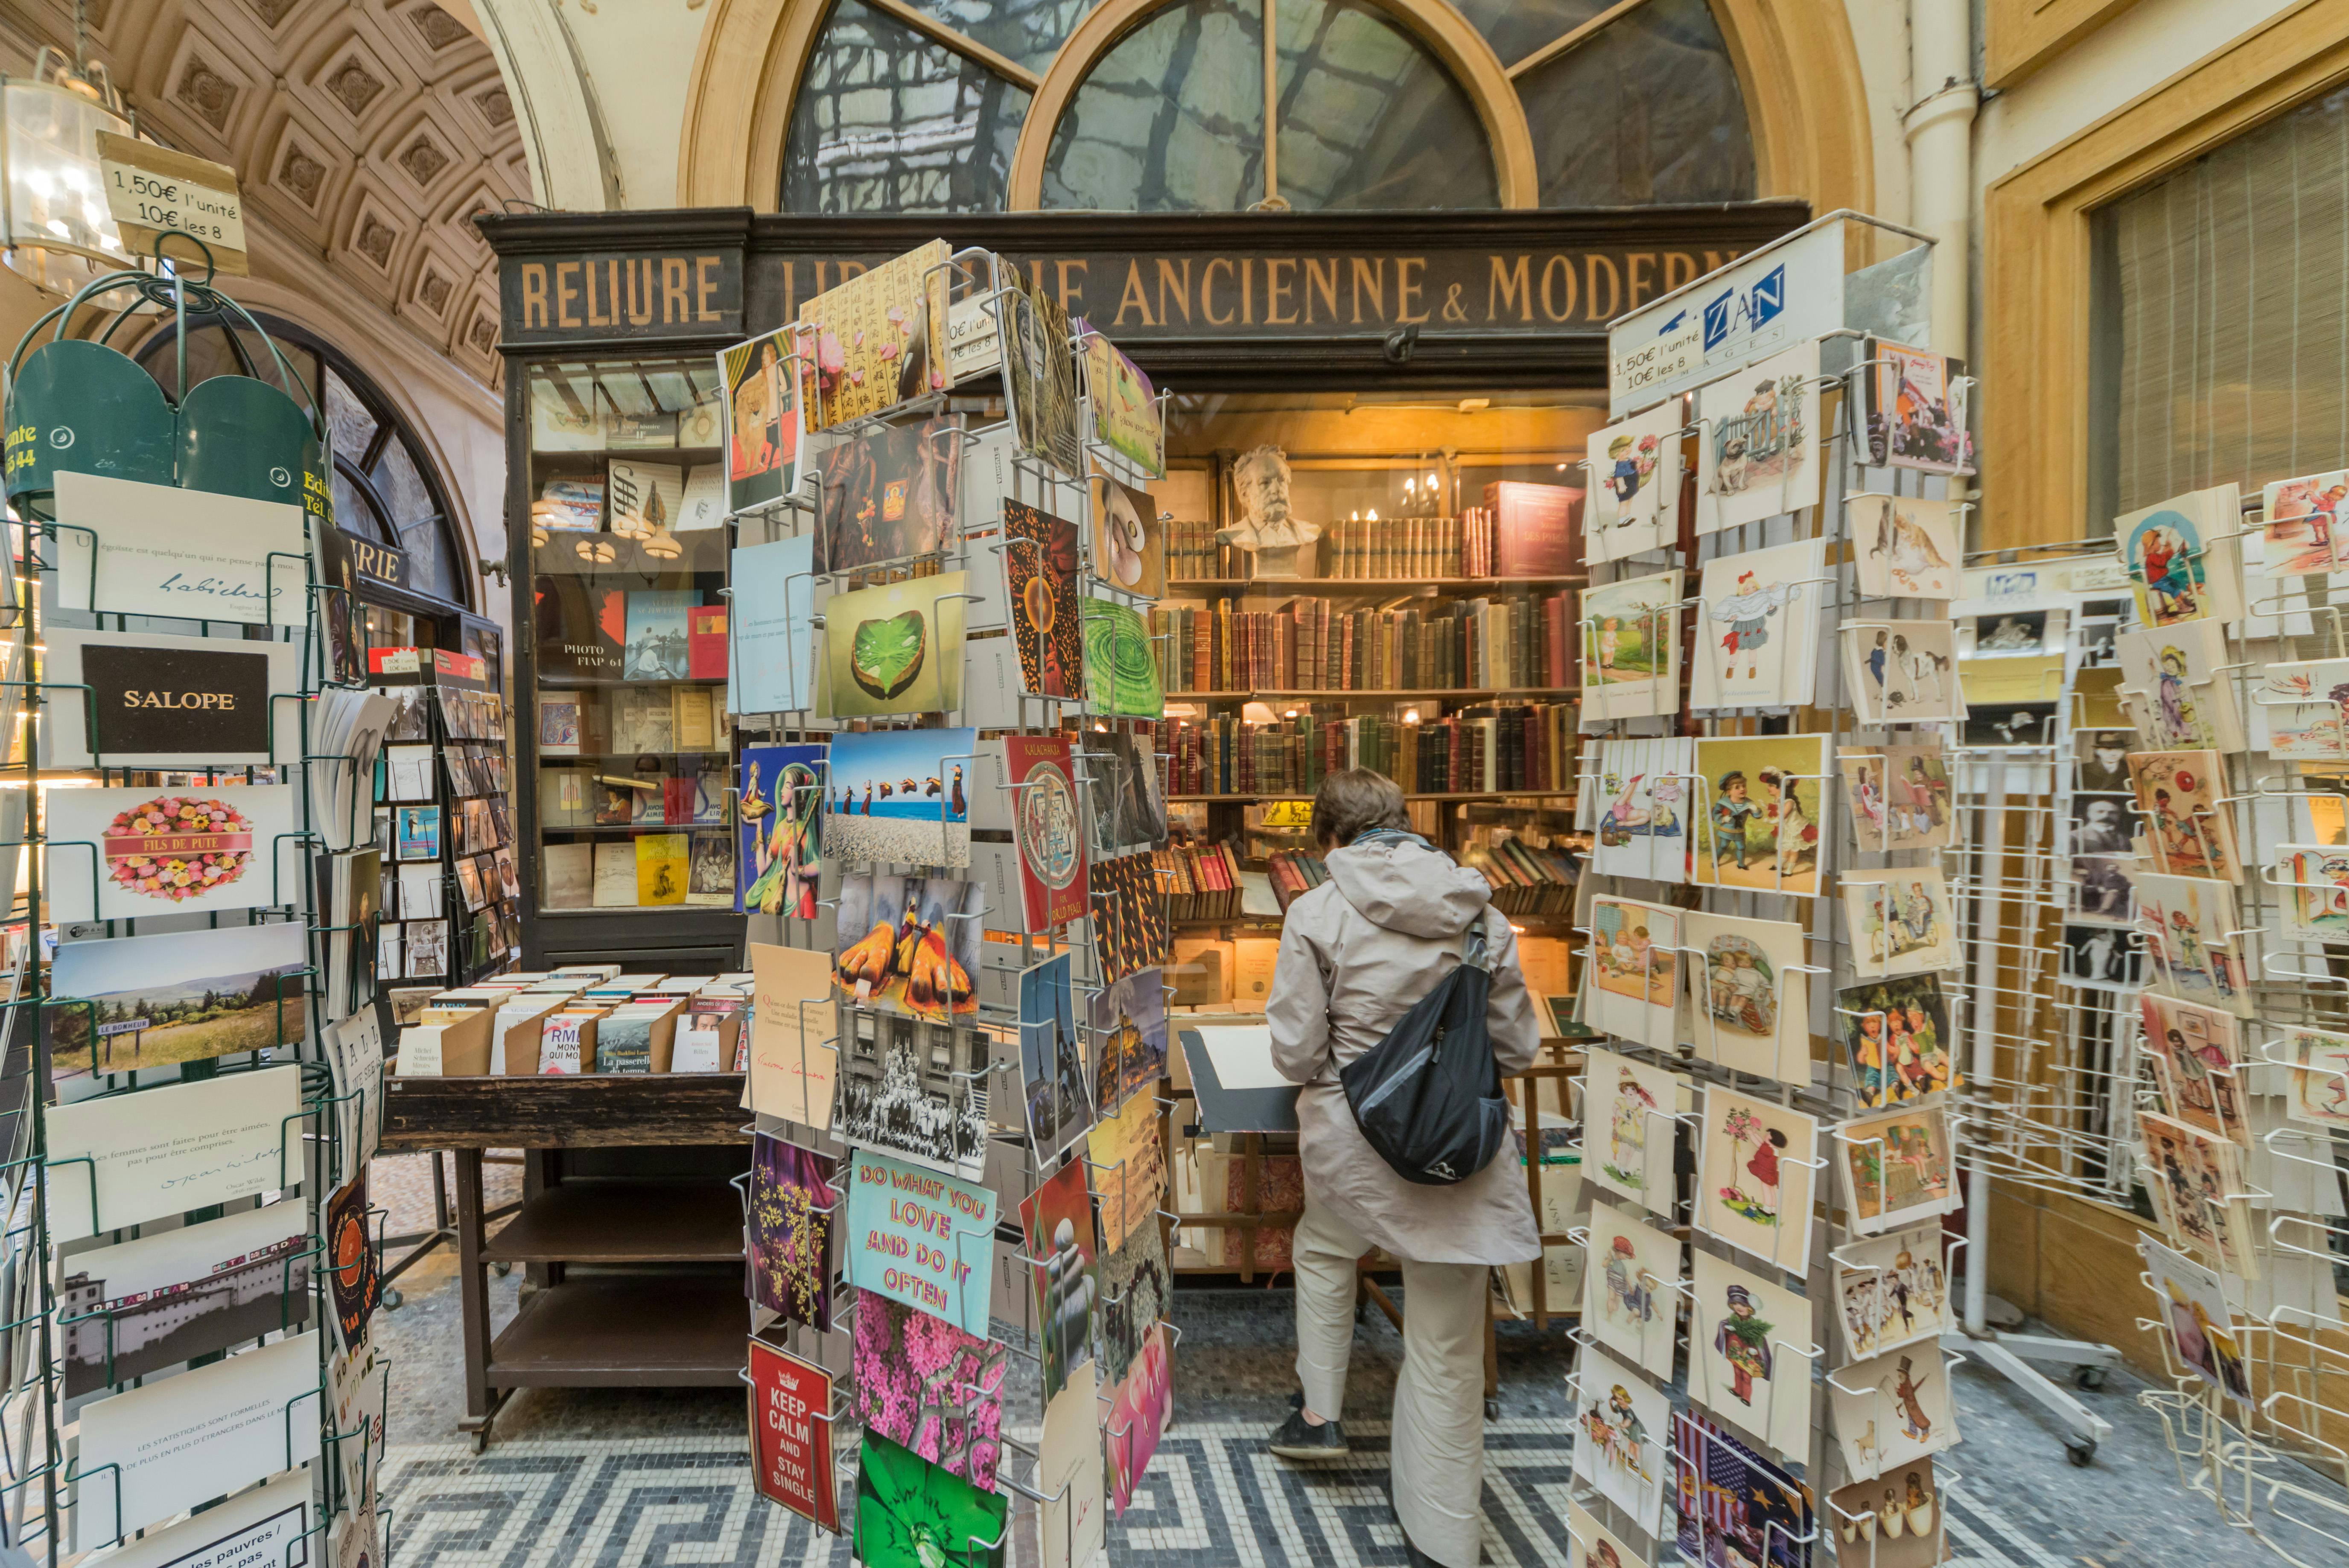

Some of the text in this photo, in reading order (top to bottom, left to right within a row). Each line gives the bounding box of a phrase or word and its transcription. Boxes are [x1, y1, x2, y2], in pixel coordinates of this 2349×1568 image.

[115, 170, 237, 220] 1,50€ l'unité
[139, 202, 222, 240] 10€ les 8
[521, 256, 721, 329] RELIURE
[1114, 256, 1429, 327] ANCIENNE
[1443, 282, 1468, 321] &
[968, 335, 991, 354] les 8
[1615, 330, 1700, 378] 1,50€ l'unité
[1627, 357, 1686, 390] 10€ les 8
[16, 449, 36, 468] 44
[303, 493, 325, 518] Tél.
[101, 542, 134, 553] égoïste
[151, 549, 197, 560] quelqu'un
[199, 554, 214, 564] qui
[229, 558, 253, 568] pense
[277, 562, 296, 571] moi.
[564, 644, 604, 654] PHOTO
[578, 656, 604, 666] FIAP
[123, 690, 235, 711] SALOPE
[1024, 743, 1061, 756] KALACHAKRA
[143, 836, 219, 852] FILS DE PUTE
[996, 864, 1005, 895] TUSHITA
[1045, 901, 1082, 921] ORLD PEACE
[1059, 894, 1068, 904] FOR
[763, 994, 786, 1008] Qu'est-ce
[786, 1003, 797, 1011] donc
[806, 1006, 824, 1016] l'amour
[781, 1011, 797, 1020] maladie
[101, 1020, 148, 1034] LE BONHEUR
[603, 1057, 613, 1066] La
[110, 1122, 271, 1160] femmes sont faites pour être aimées.
[127, 1140, 235, 1169] pas pour être comprises.
[226, 1176, 266, 1190] Oscar Wilde
[860, 1165, 987, 1221] DO WHAT YOU
[890, 1198, 952, 1241] LOVE
[212, 1237, 300, 1274] META MERDA
[866, 1230, 972, 1287] AND DO IT
[884, 1267, 948, 1312] OFTEN
[1003, 1262, 1011, 1289] TUSHITA
[92, 1282, 190, 1313] DREAM TEAM
[770, 1387, 806, 1419] KEEP
[137, 1399, 271, 1452] LES STATISTIQUES SONT FORMELLES
[769, 1409, 810, 1446] CALM
[127, 1461, 137, 1471] DE
[140, 1454, 159, 1466] PLUS
[160, 1449, 171, 1458] EN
[173, 1442, 191, 1454] PLUS
[193, 1422, 244, 1446] D'ÉTRANGERS
[246, 1414, 266, 1426] DANS
[267, 1410, 275, 1418] LE
[779, 1438, 800, 1459] AND
[777, 1455, 806, 1482] STAY
[772, 1471, 815, 1504] SINGLE
[217, 1530, 273, 1565] pauvres
[238, 1550, 263, 1568] pas
